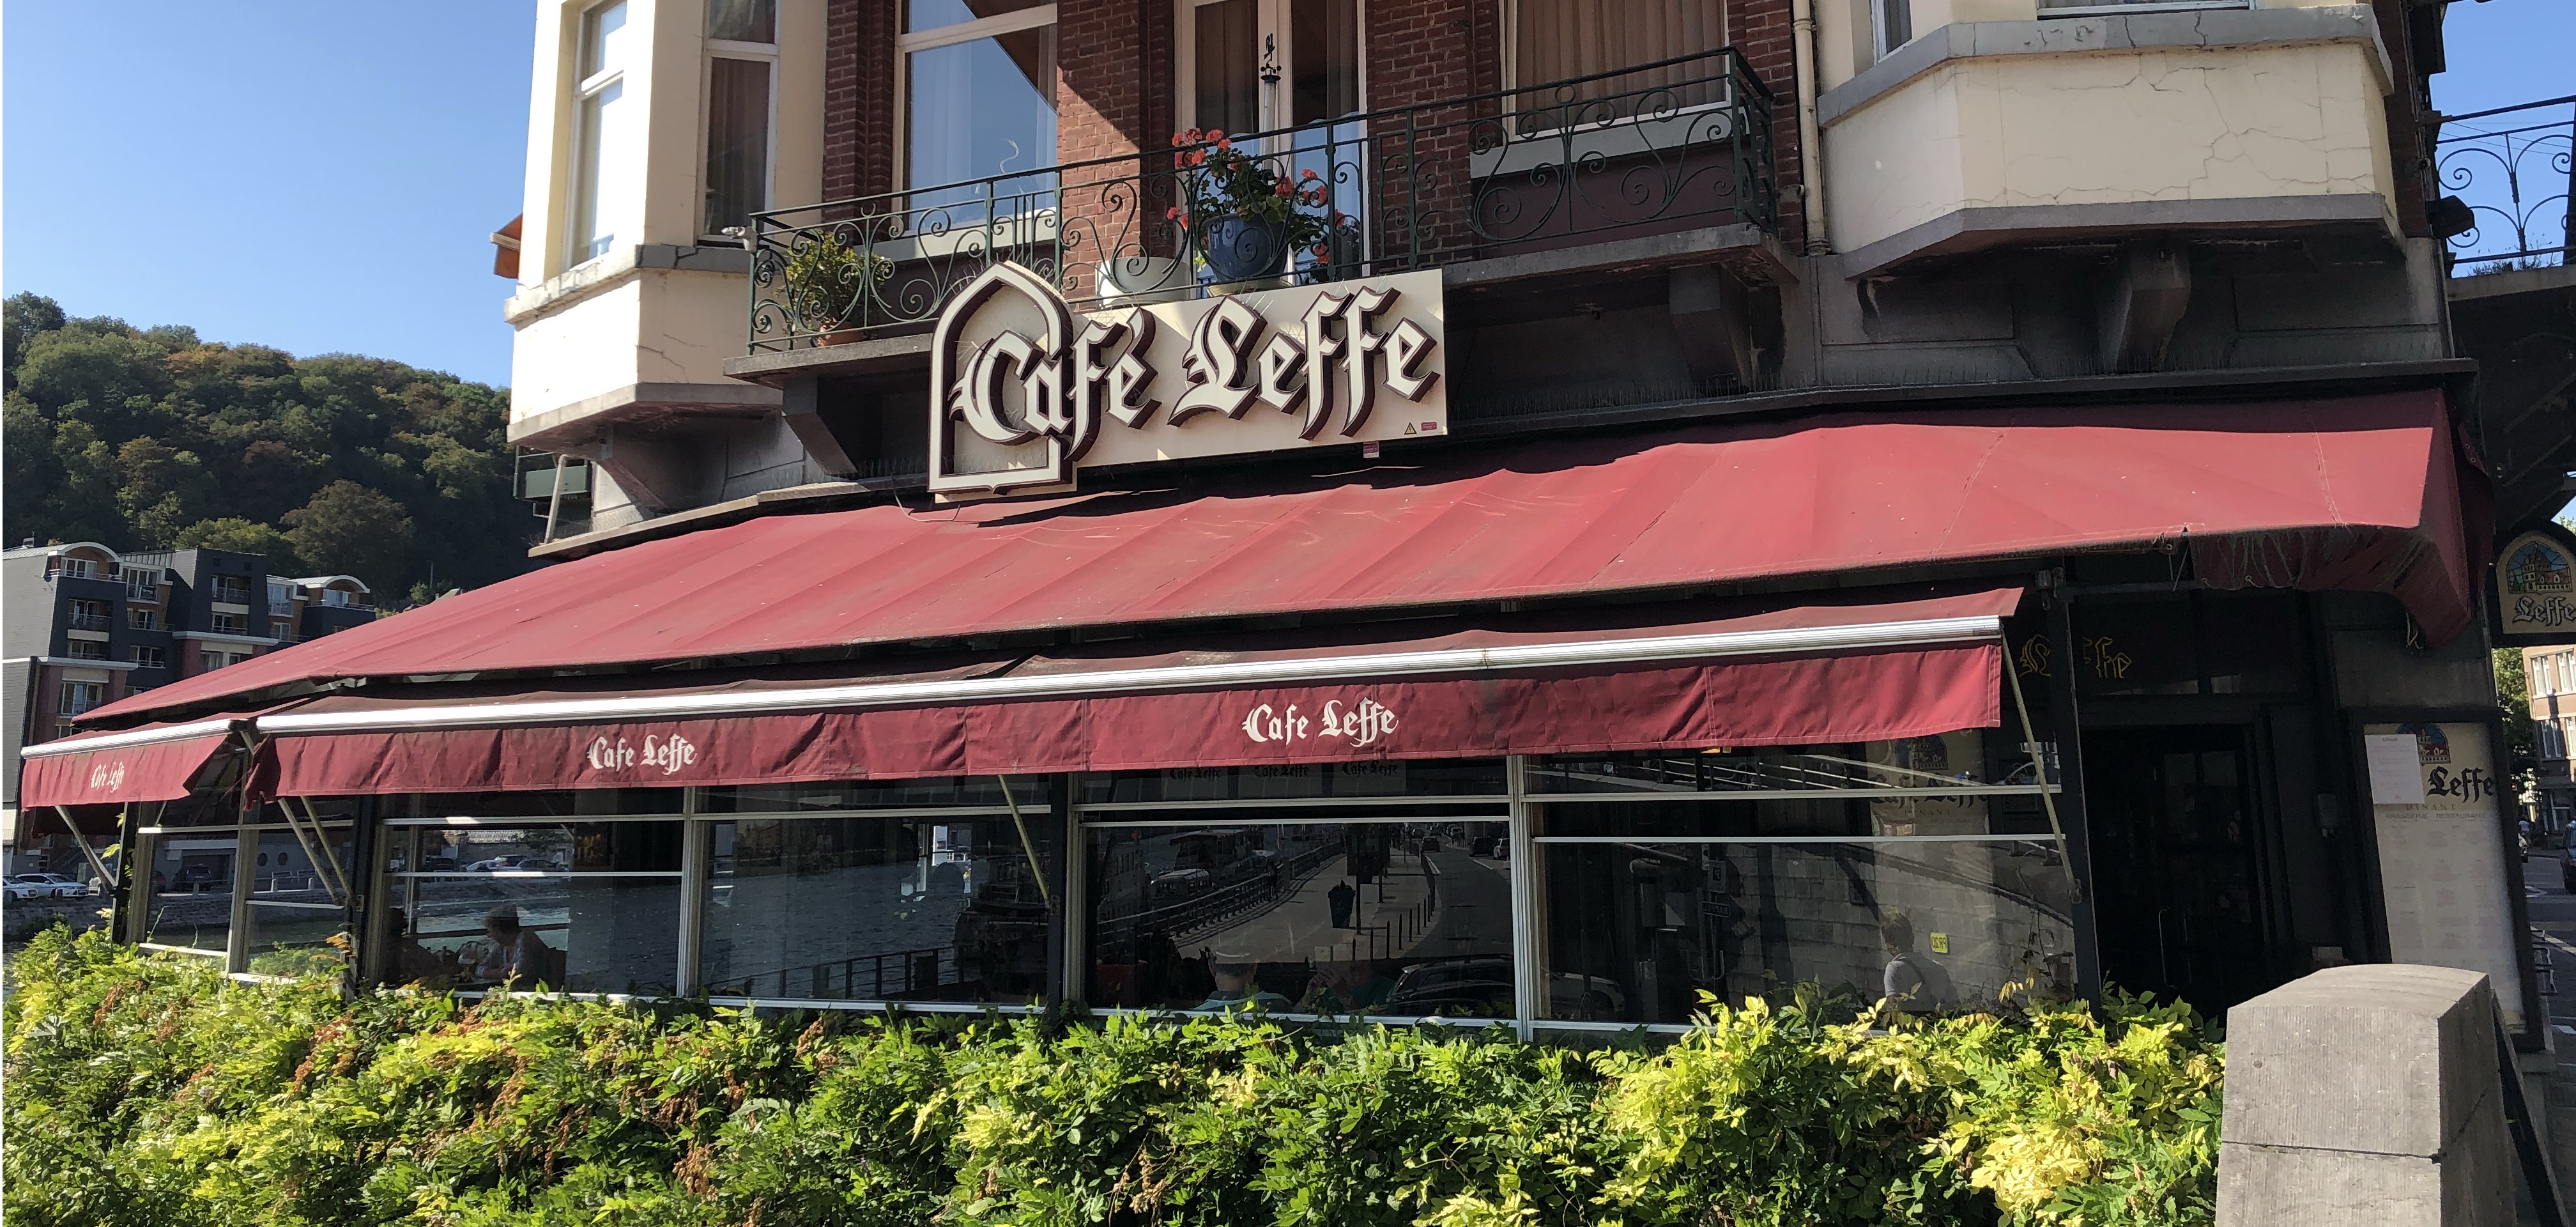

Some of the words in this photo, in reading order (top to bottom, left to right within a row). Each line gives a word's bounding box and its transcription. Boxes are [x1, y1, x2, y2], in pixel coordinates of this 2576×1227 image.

[949, 307, 1162, 461] Café
[1167, 286, 1441, 440] Leffe
[2512, 596, 2576, 627] Leffe
[1242, 704, 1309, 746] Cafe
[1318, 697, 1399, 748] Leffe
[586, 736, 635, 772] Cafe
[640, 733, 698, 775] Leffe
[2426, 766, 2494, 803] Leffe
